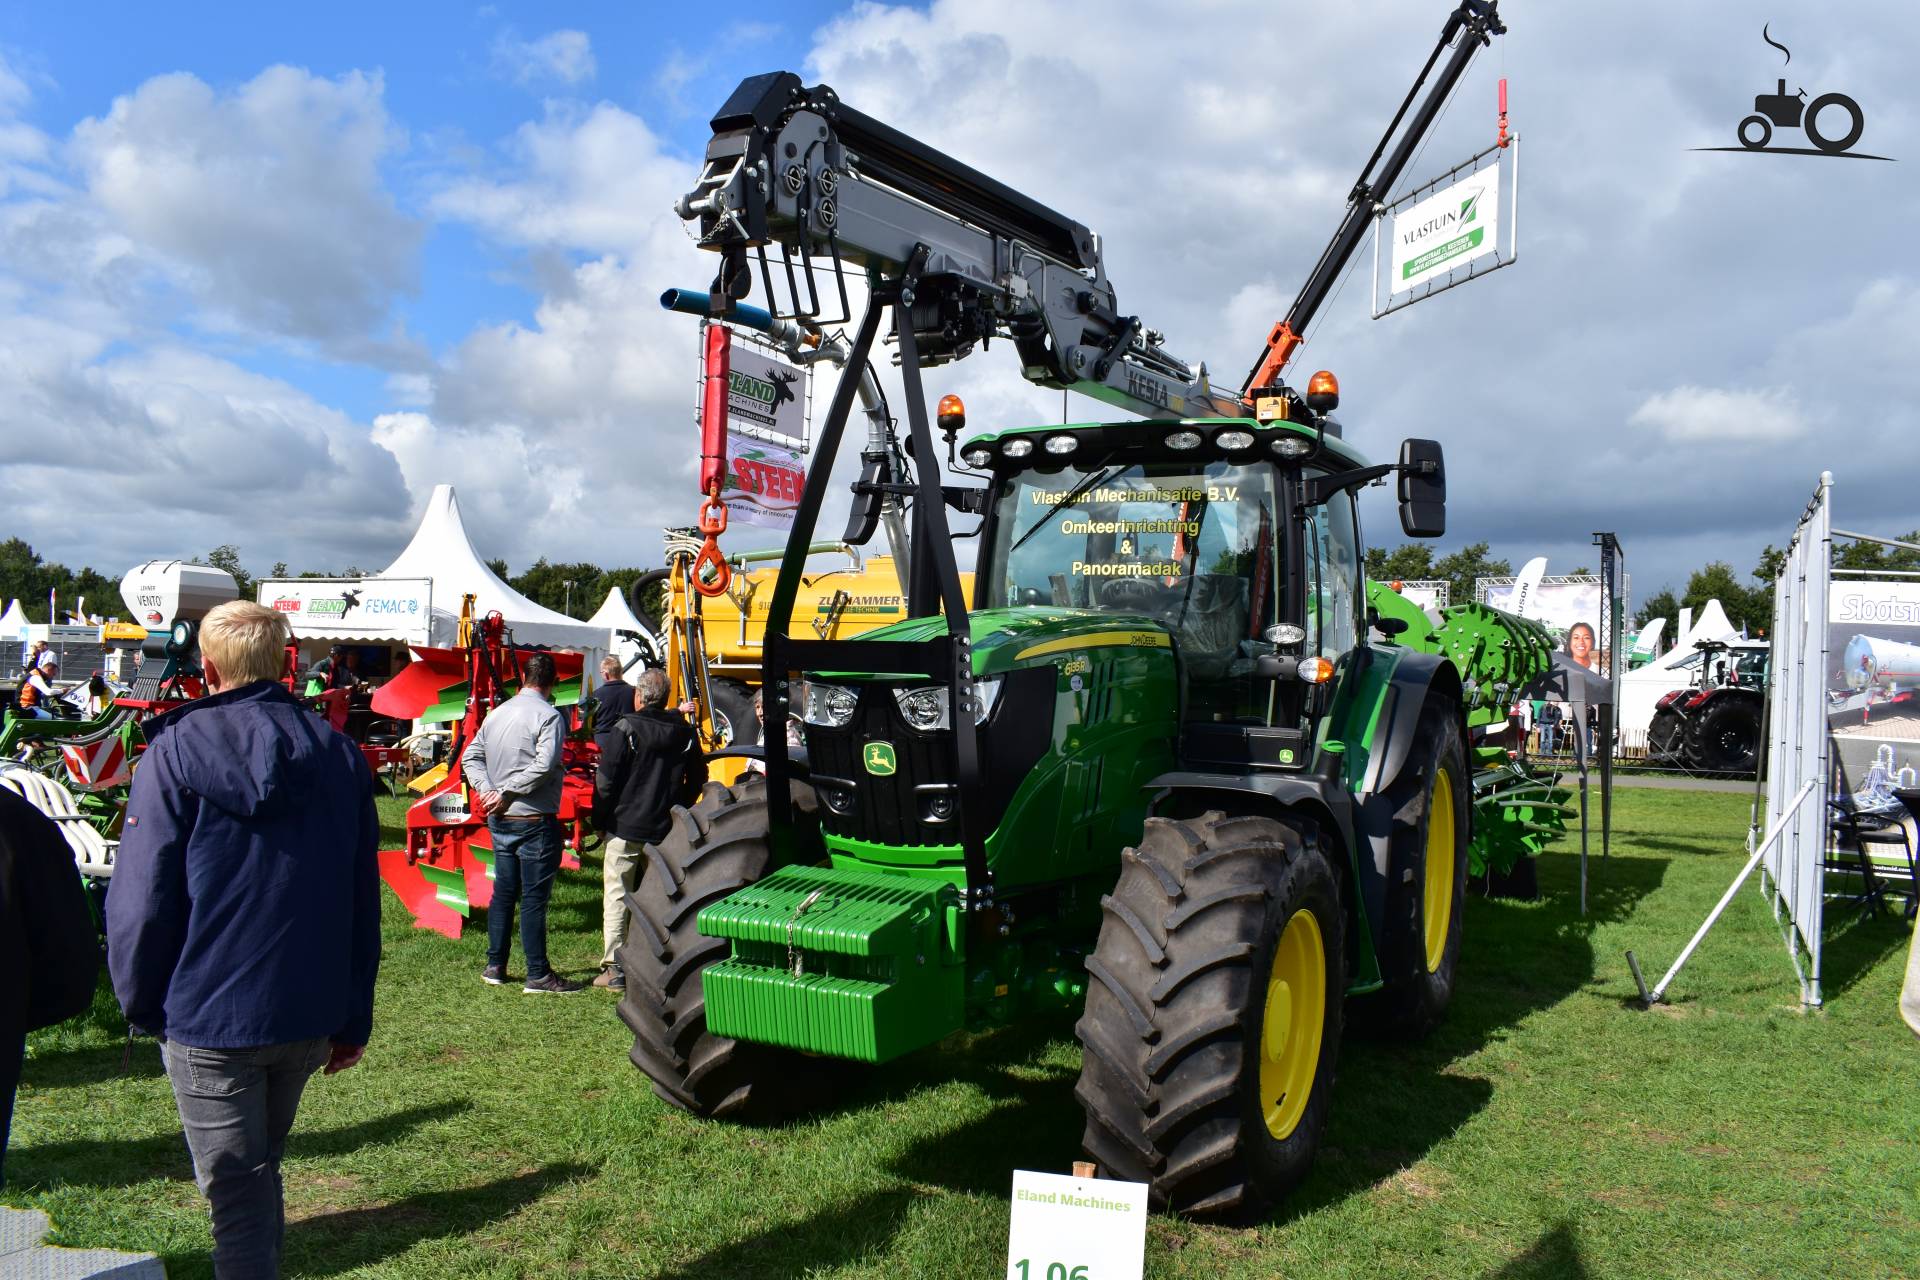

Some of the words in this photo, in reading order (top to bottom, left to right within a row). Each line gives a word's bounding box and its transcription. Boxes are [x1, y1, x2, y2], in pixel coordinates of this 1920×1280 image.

[1404, 209, 1456, 246] VLASTUIN
[729, 373, 773, 402] LAND
[1128, 370, 1168, 408] KESLA
[728, 394, 770, 413] ACHINES
[1095, 487, 1202, 503] Mechanisatie
[1207, 487, 1240, 501] B.V.
[1061, 519, 1200, 537] Omkeerinrichting
[1120, 540, 1133, 554] &
[1072, 561, 1182, 577] Panoramadak
[365, 598, 406, 614] FEMAC
[1016, 1189, 1057, 1204] Eland
[1060, 1193, 1132, 1212] Machines
